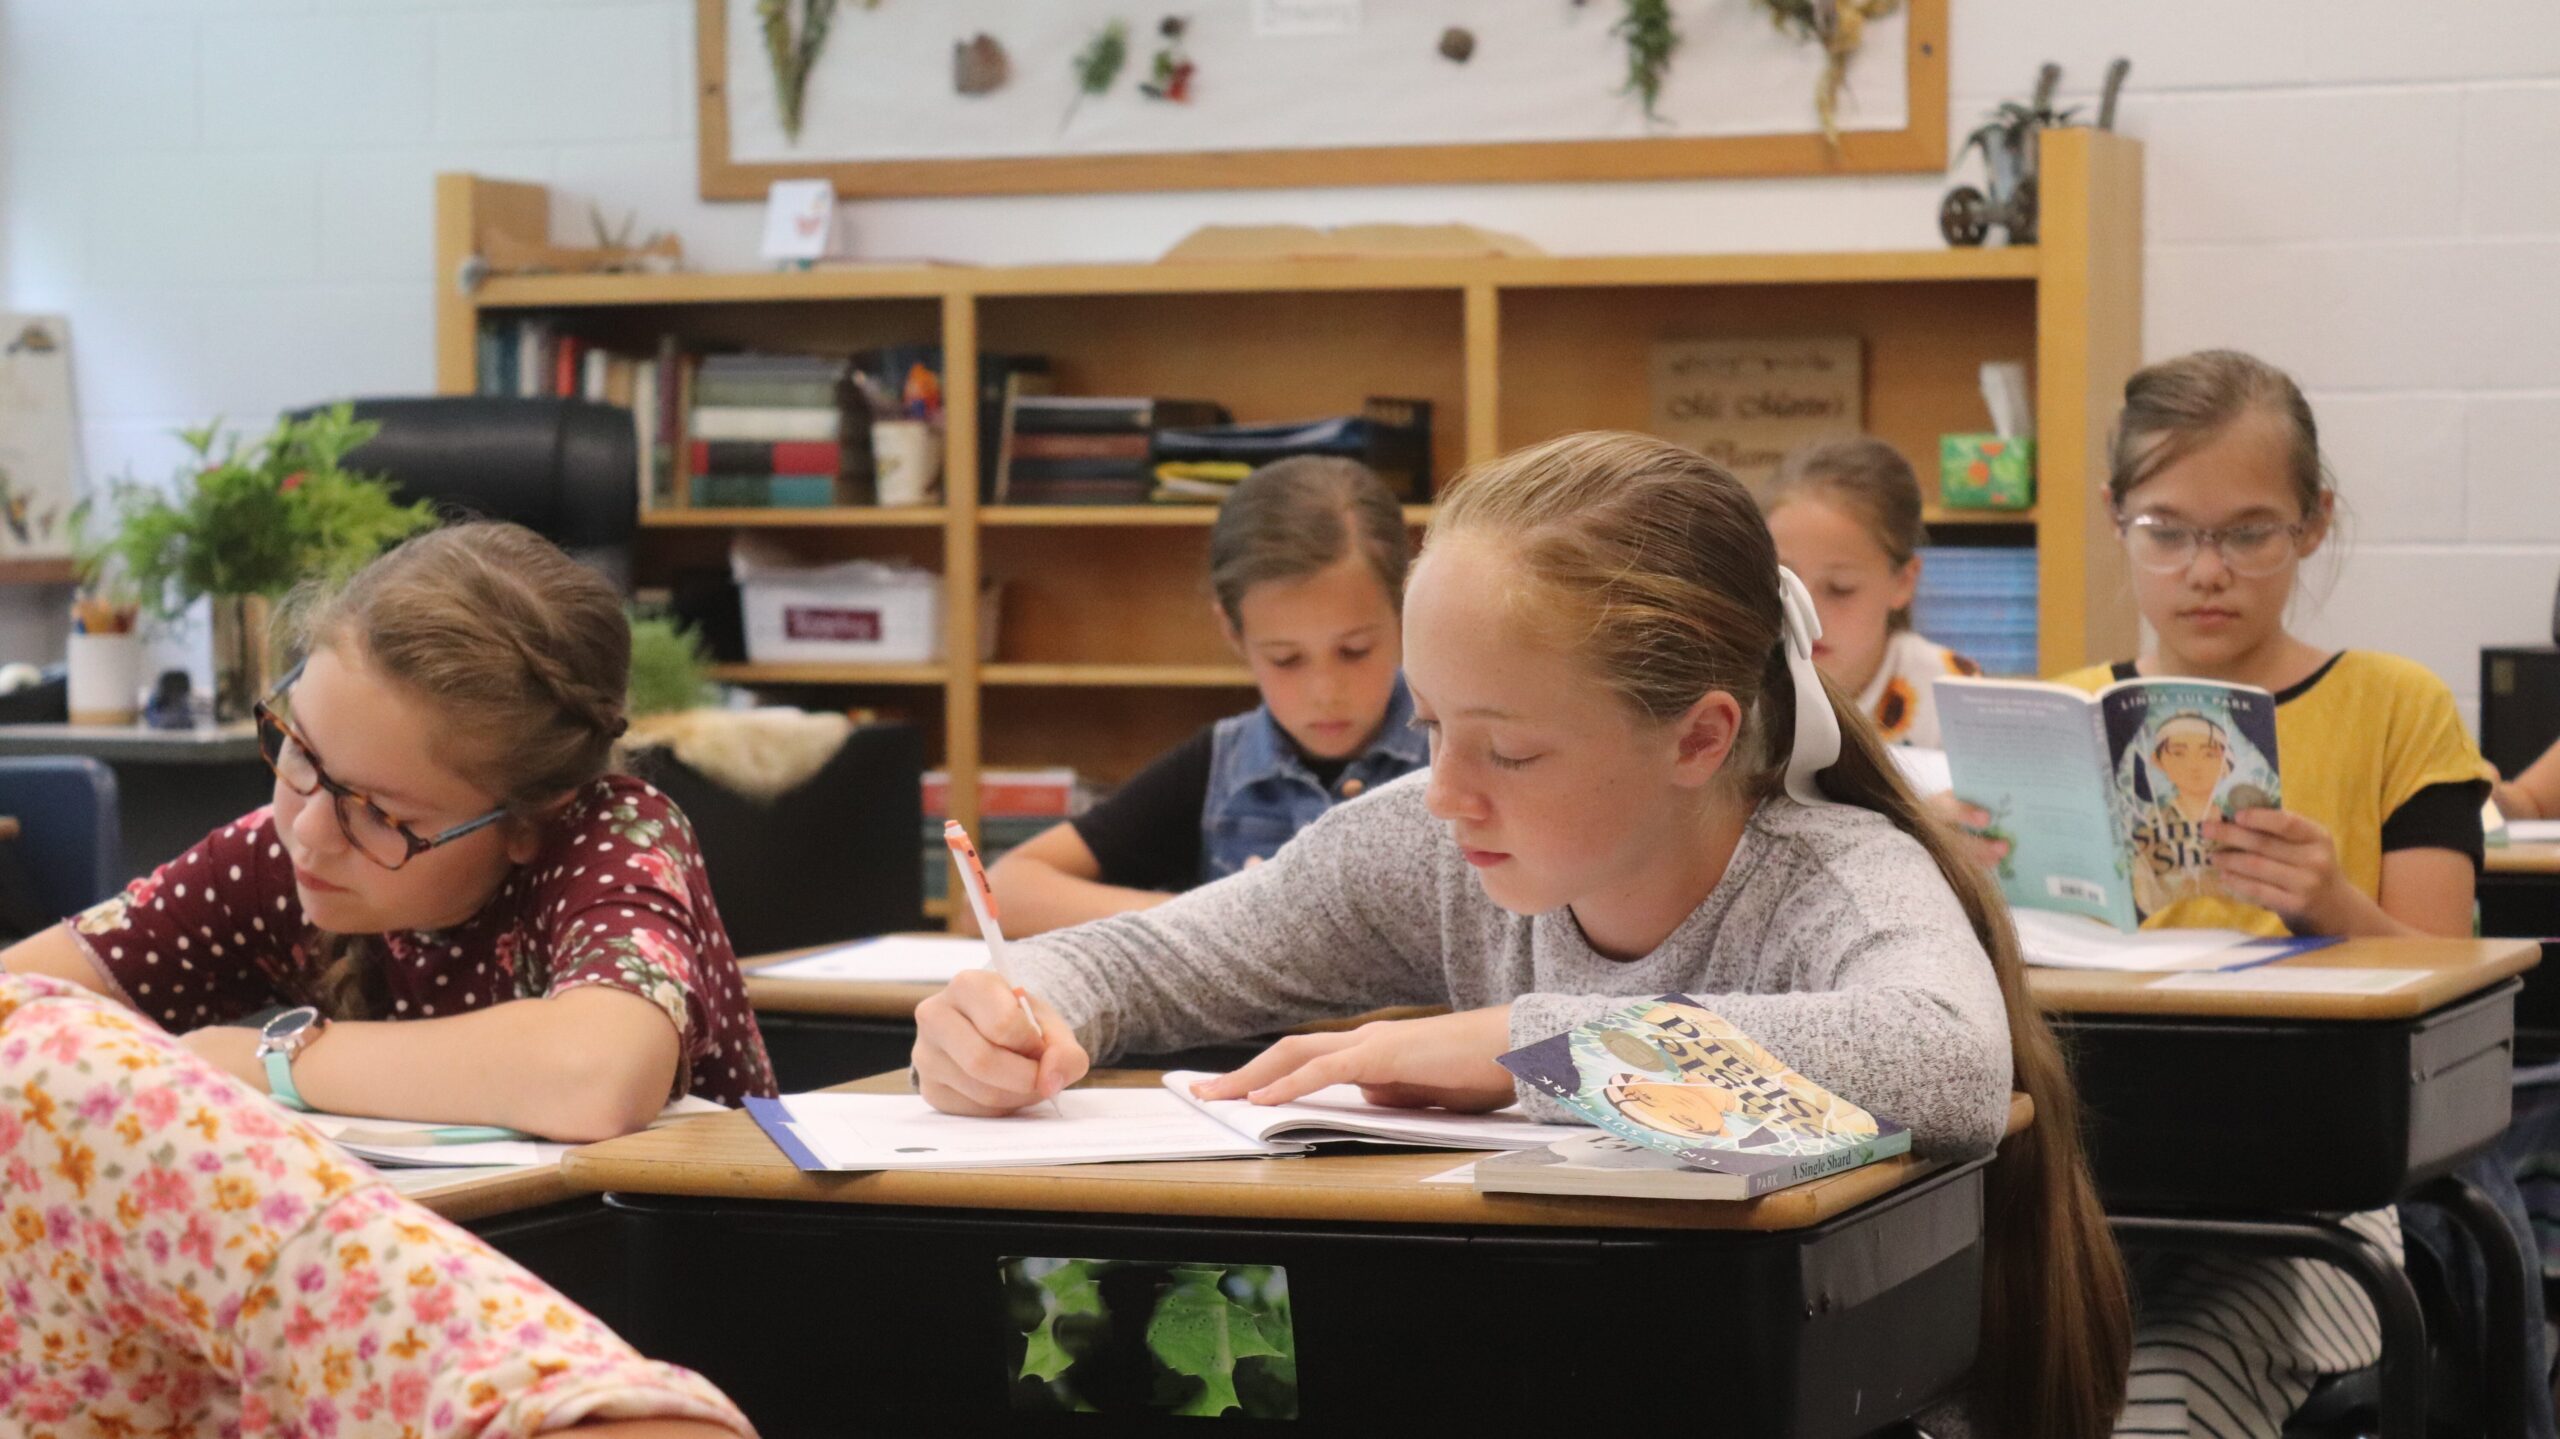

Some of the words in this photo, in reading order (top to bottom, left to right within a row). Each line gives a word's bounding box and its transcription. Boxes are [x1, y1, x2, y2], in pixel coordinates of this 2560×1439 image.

[2121, 694, 2168, 710] LINDA
[2177, 693, 2204, 703] SUE
[2212, 696, 2250, 711] PARK
[1658, 1014, 1824, 1118] Shard
[1536, 1075, 1592, 1110] PARK
[1657, 1036, 1836, 1138] Single
[1601, 1115, 1641, 1136] SUE
[1653, 1138, 1720, 1166] LINDA
[1756, 1174, 1778, 1190] PARK
[1791, 1165, 1798, 1180] A
[1800, 1158, 1824, 1178] Single
[1827, 1150, 1850, 1171] Shard
